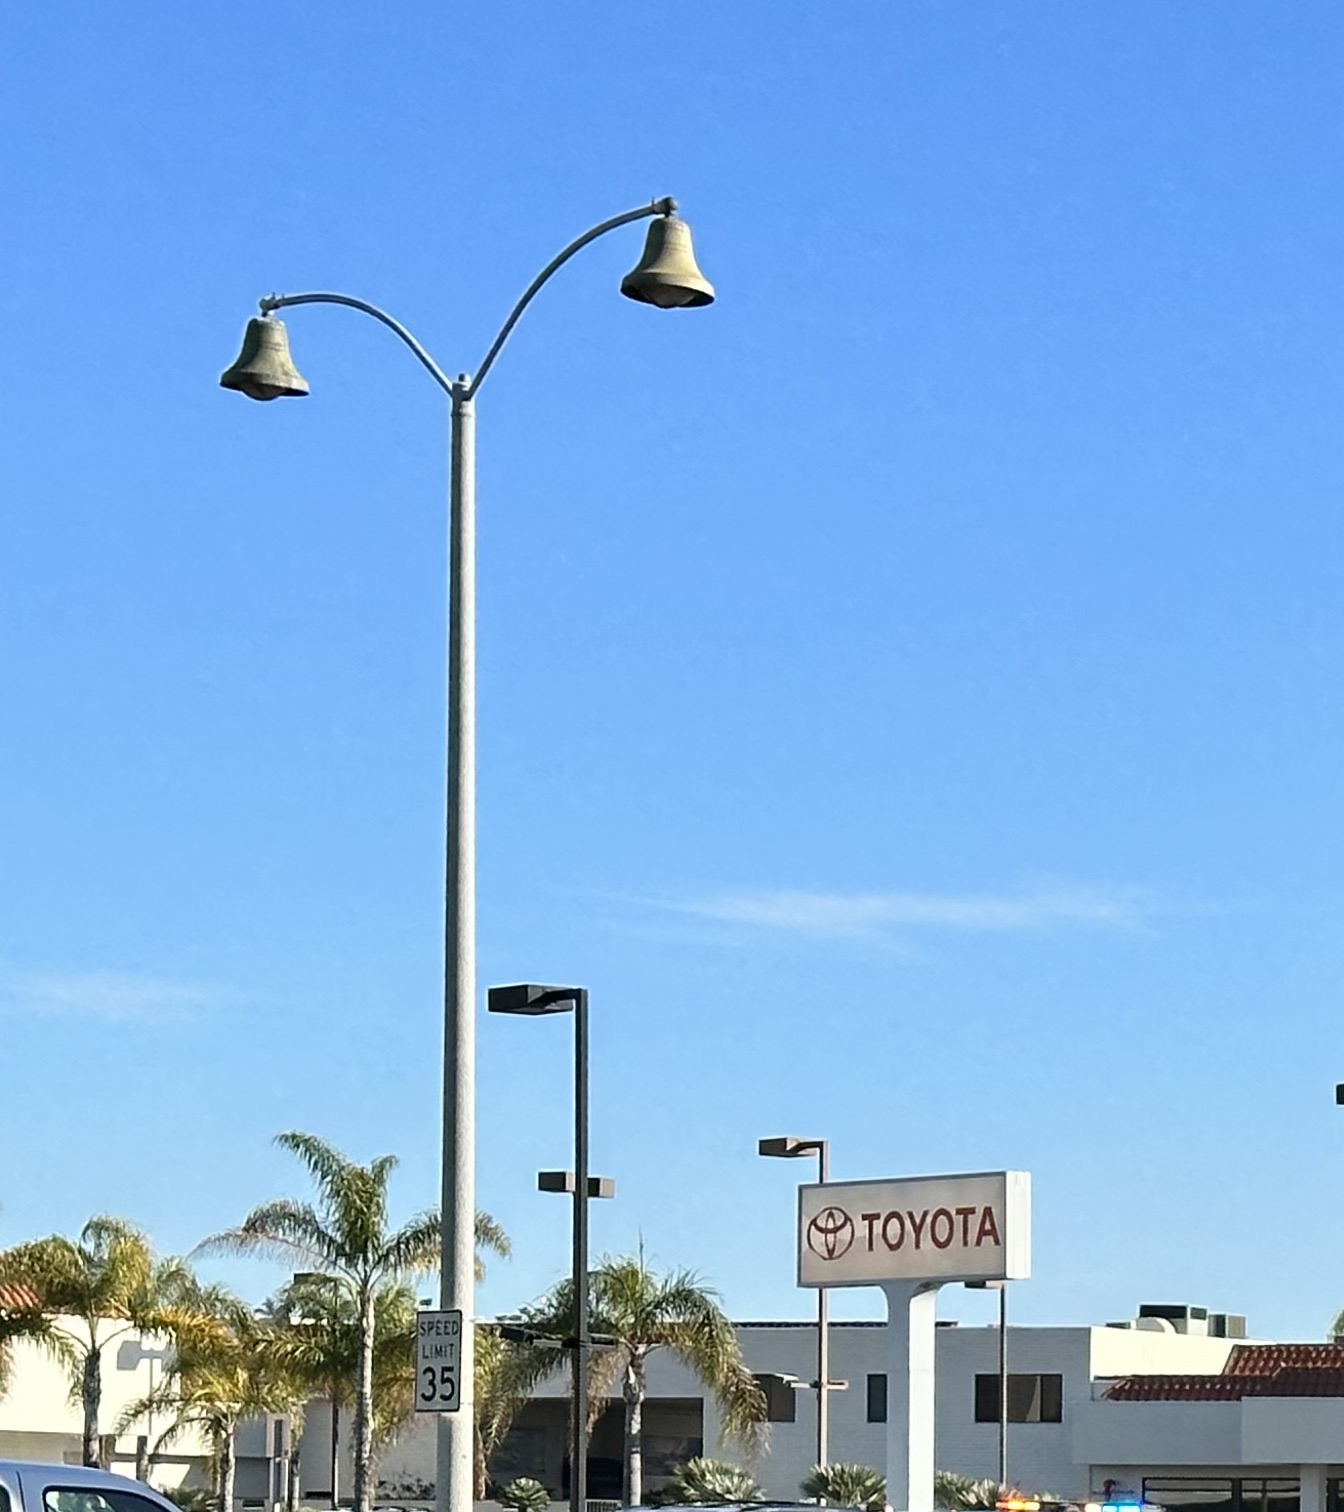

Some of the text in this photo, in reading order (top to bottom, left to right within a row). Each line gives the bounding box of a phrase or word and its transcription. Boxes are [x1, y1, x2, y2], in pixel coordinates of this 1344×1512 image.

[861, 1206, 1001, 1252] TOYOTA
[420, 1320, 459, 1336] SPEED
[422, 1343, 454, 1359] LIMIT
[420, 1366, 455, 1402] 35
